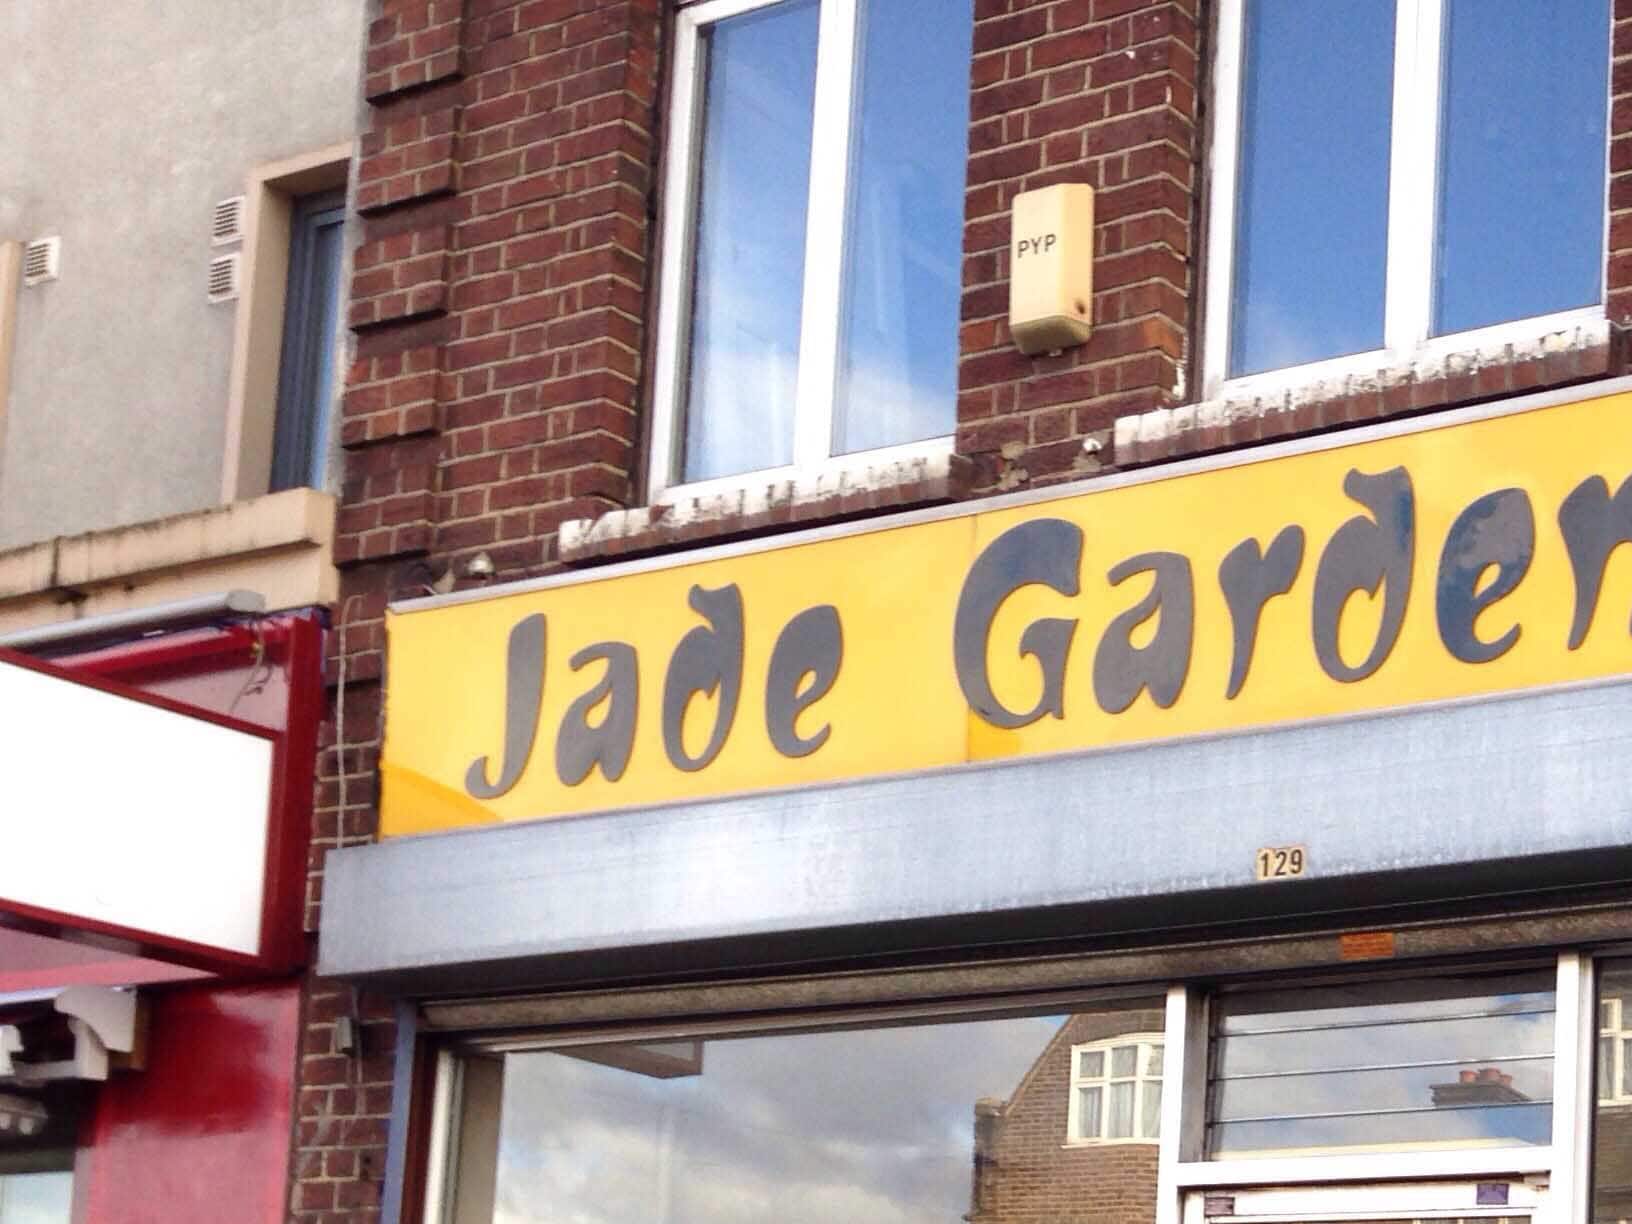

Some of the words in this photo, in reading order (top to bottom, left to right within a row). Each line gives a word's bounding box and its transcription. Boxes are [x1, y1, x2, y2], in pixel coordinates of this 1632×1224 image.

[1017, 233, 1057, 259] PYP
[464, 583, 843, 799] Jade
[1260, 850, 1304, 877] 129
